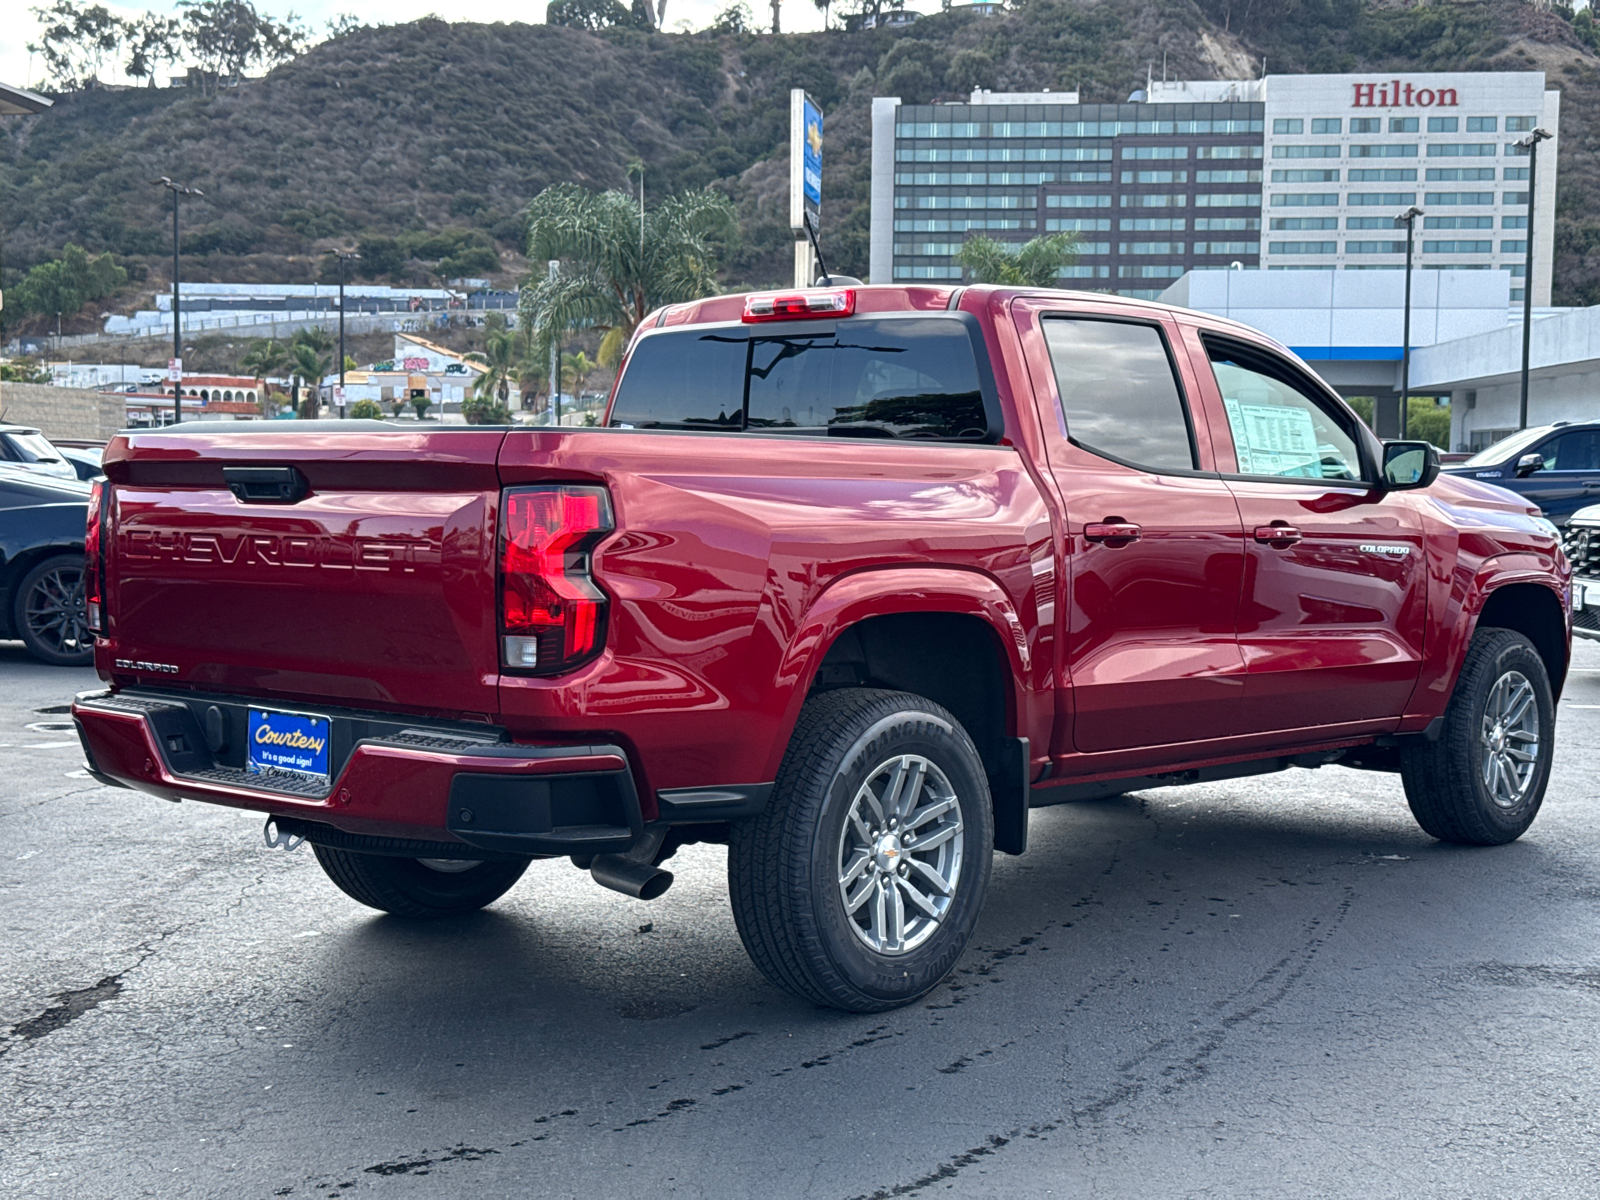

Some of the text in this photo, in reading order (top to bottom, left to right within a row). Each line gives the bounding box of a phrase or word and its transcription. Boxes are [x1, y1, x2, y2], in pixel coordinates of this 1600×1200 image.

[1351, 79, 1460, 108] Hilton
[125, 530, 437, 573] CHEVROLET
[1360, 544, 1410, 555] COLORADO
[115, 658, 179, 674] COLORADO
[255, 724, 325, 755] Courtesy
[850, 719, 946, 775] WRANGLER
[262, 750, 313, 768] It's a good sign!
